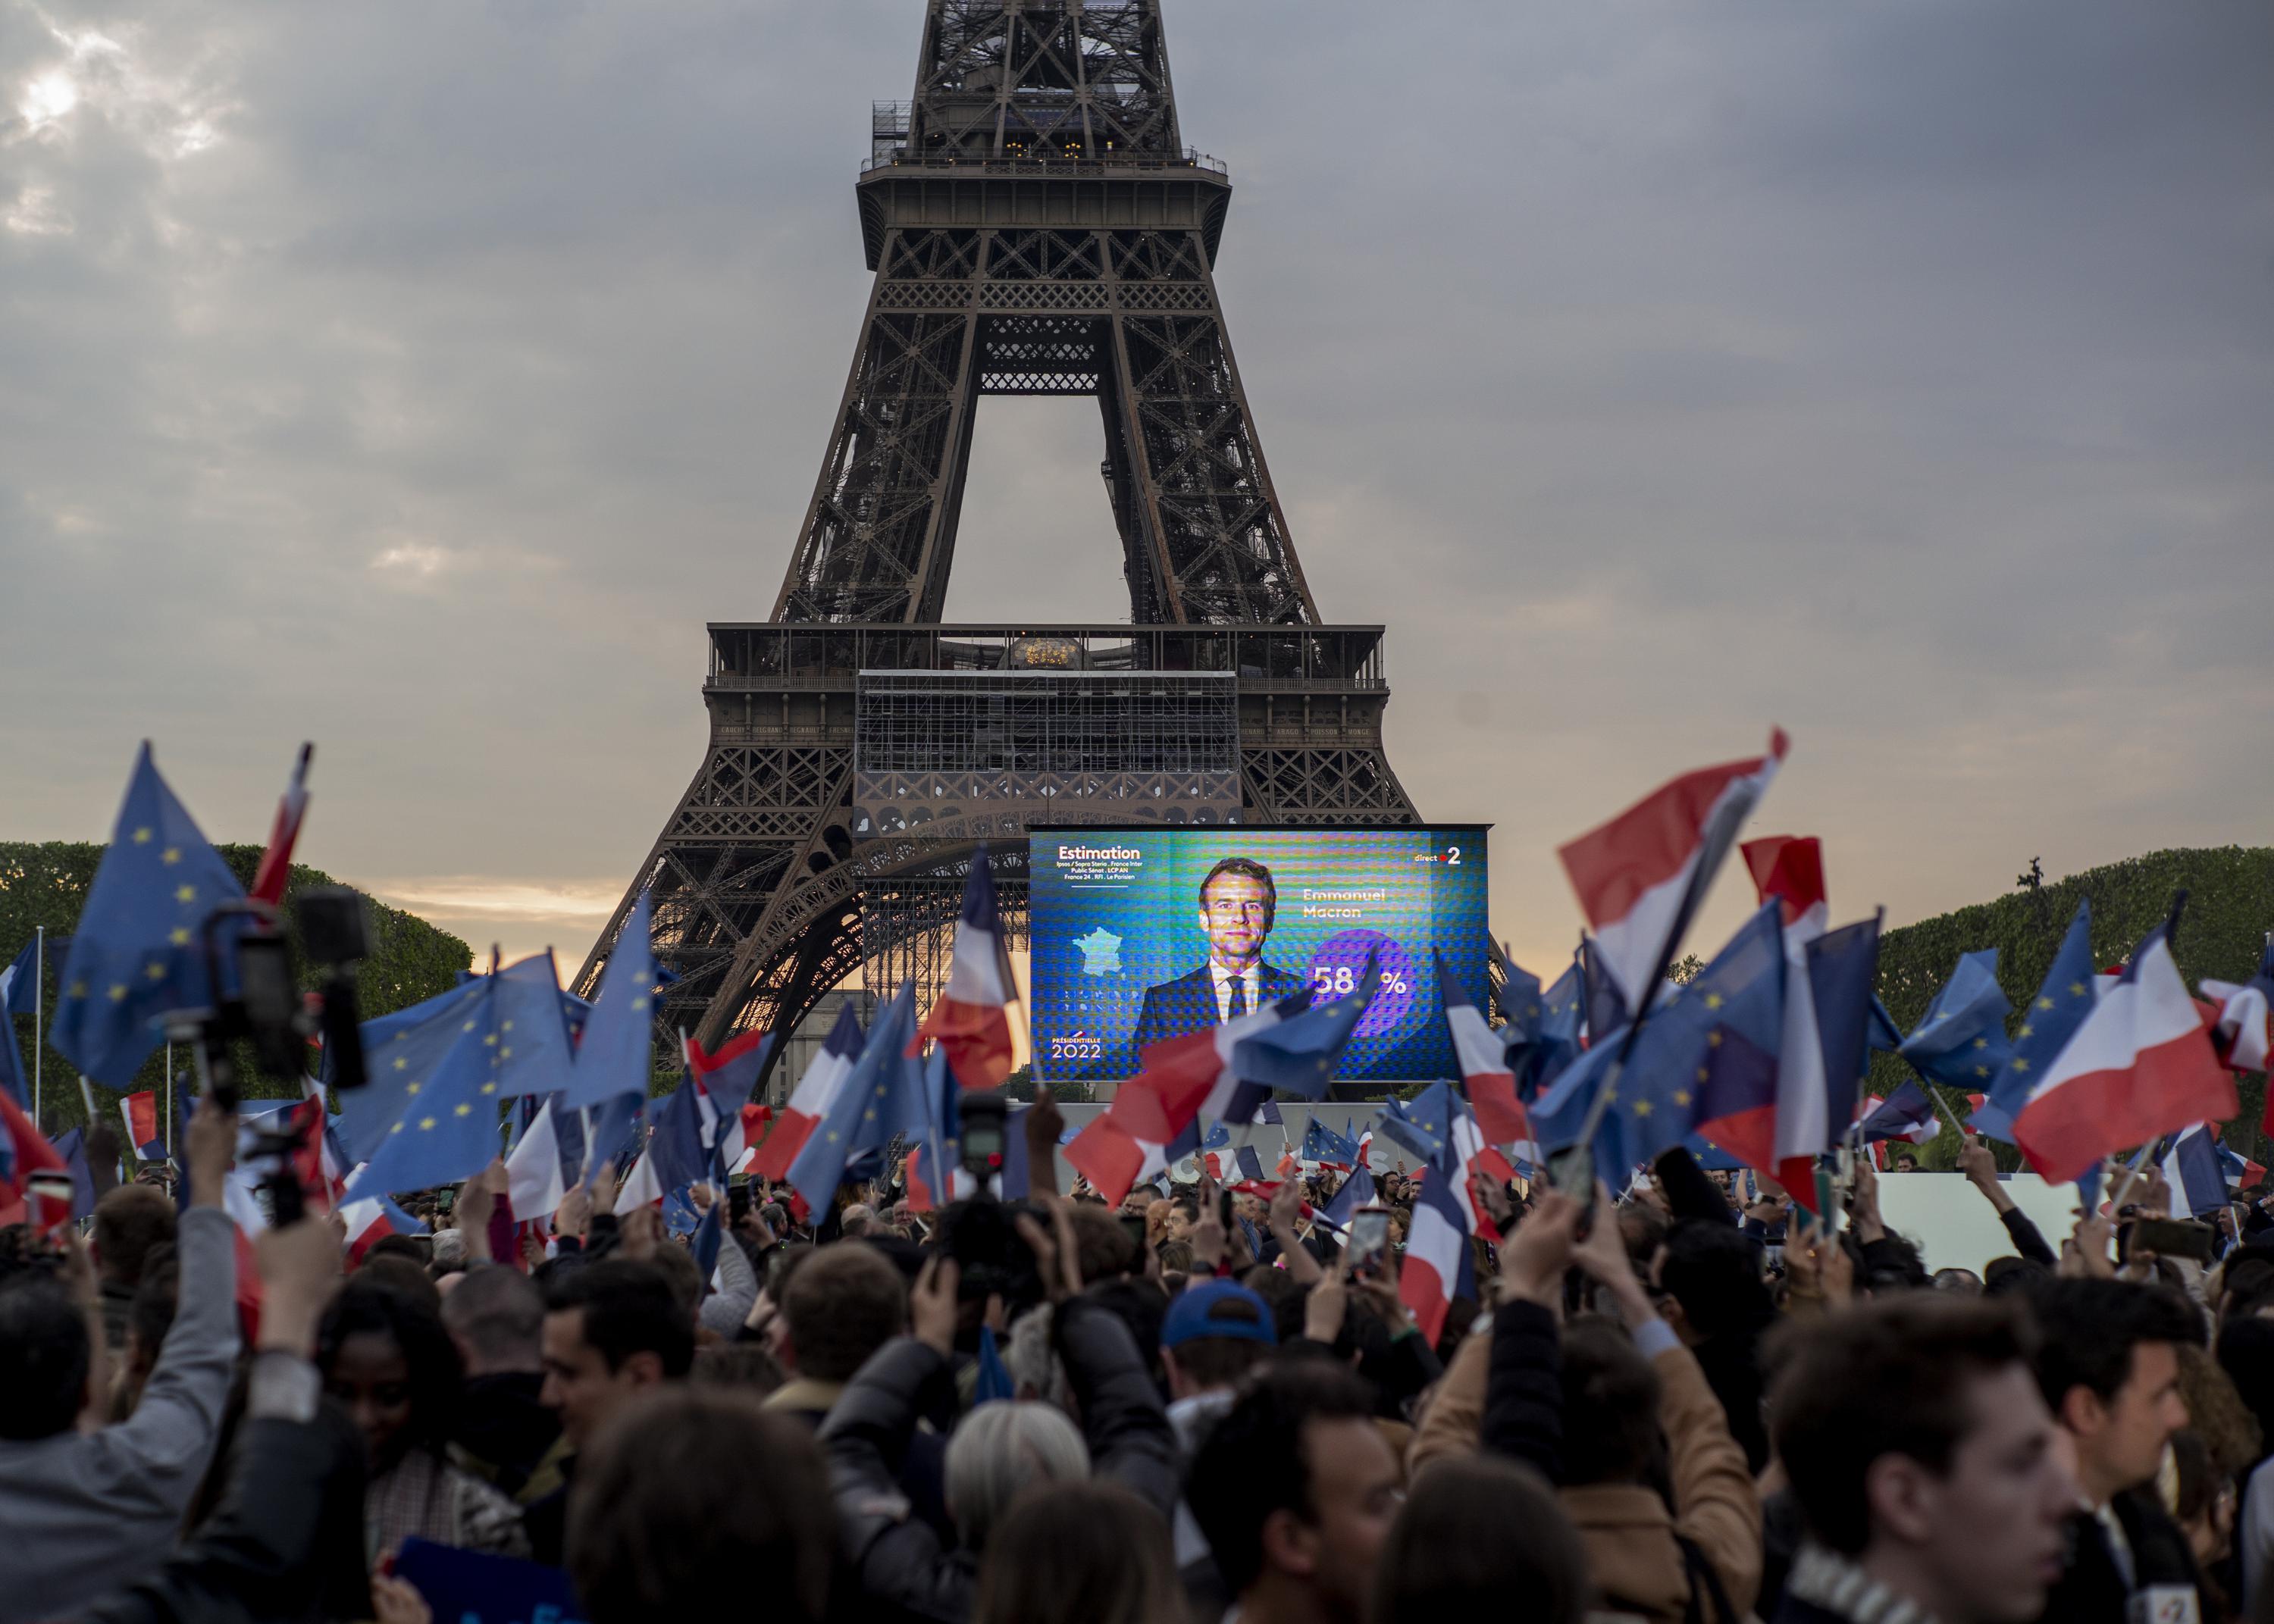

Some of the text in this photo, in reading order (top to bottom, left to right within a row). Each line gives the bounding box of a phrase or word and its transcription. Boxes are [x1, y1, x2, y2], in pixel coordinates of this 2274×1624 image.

[1058, 845, 1141, 860] Estimation
[1414, 846, 1461, 865] direct 2
[1302, 889, 1386, 901] Emmanuel
[1302, 906, 1362, 918] Macron
[1051, 1044, 1101, 1059] 2022
